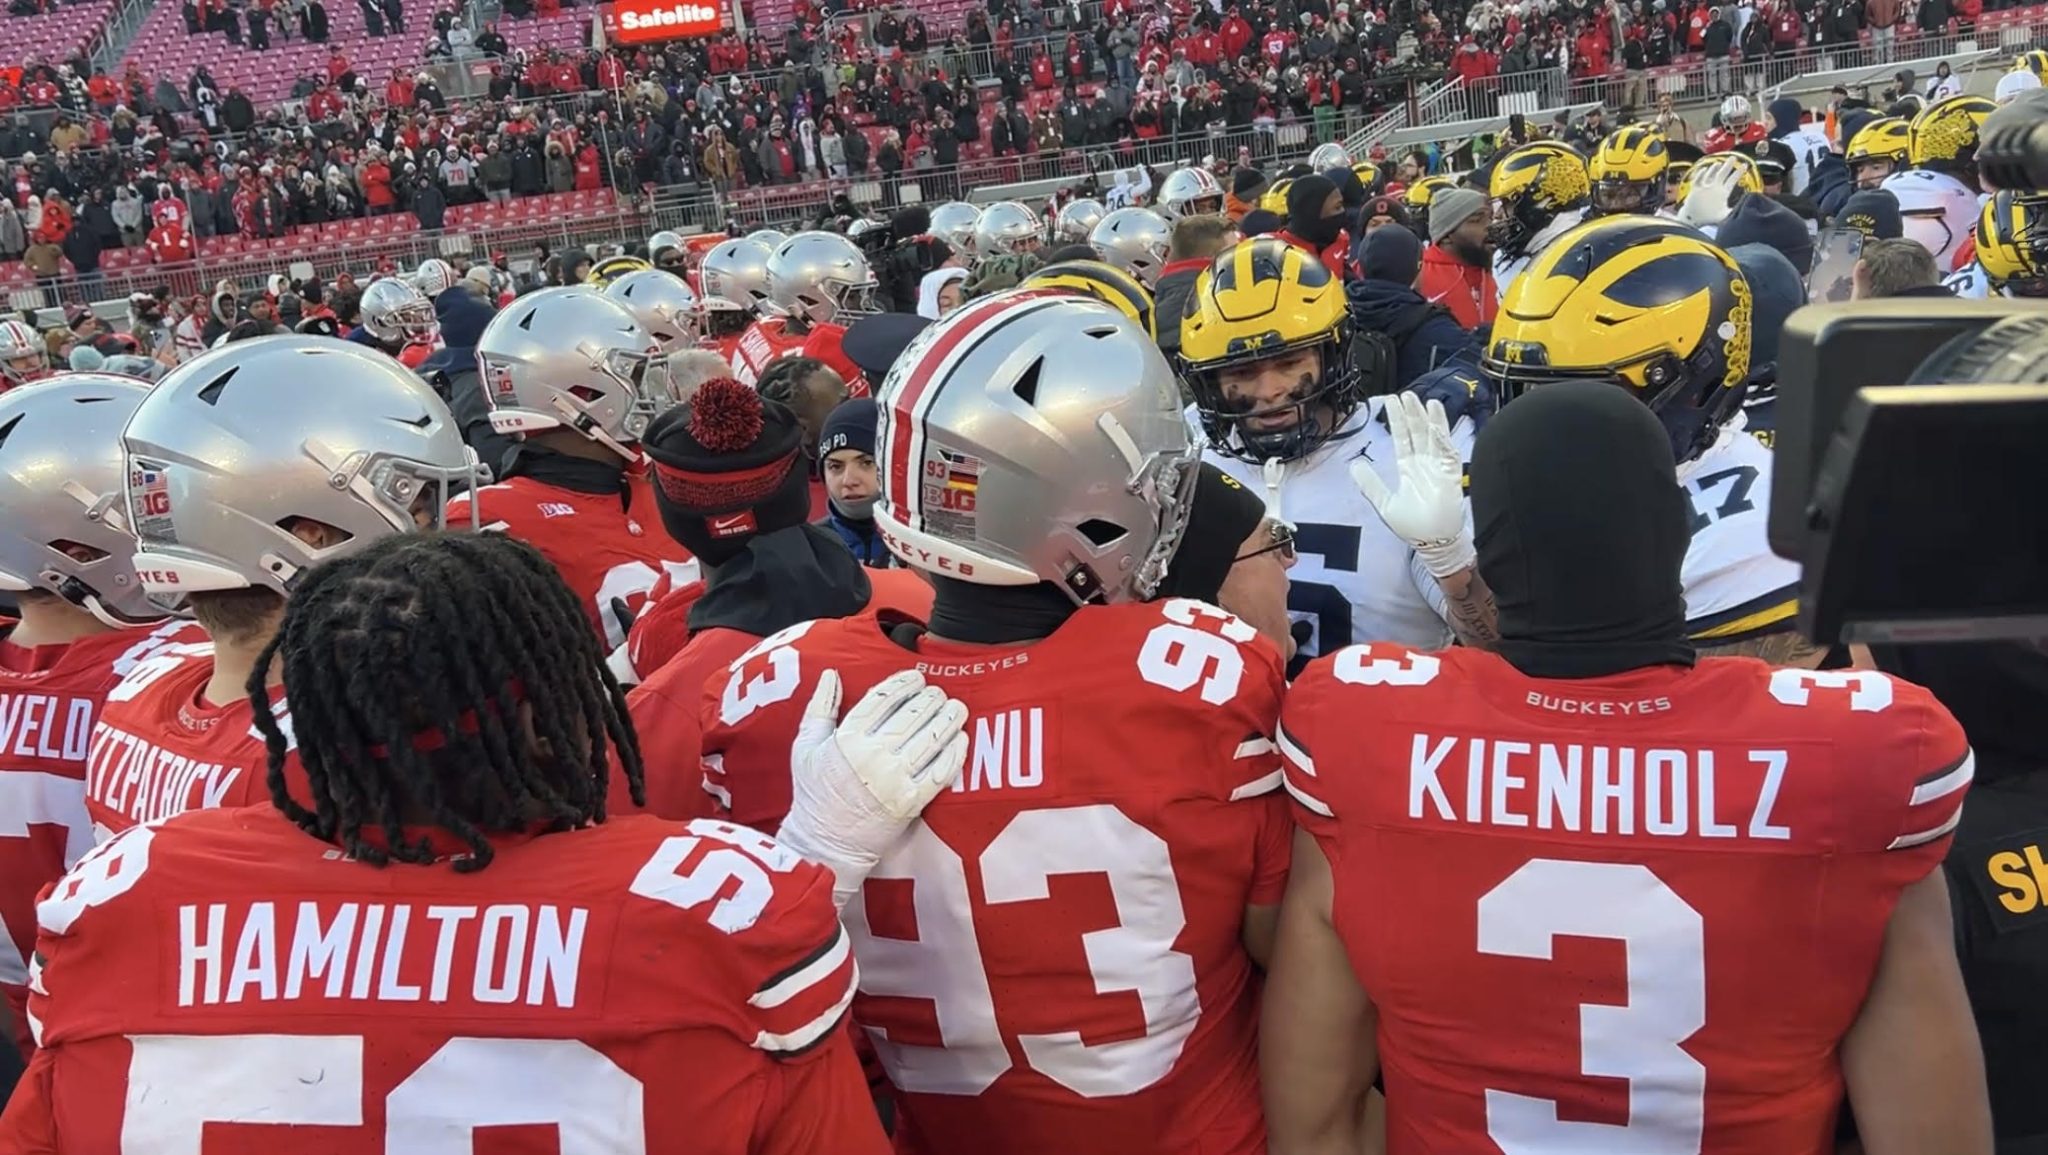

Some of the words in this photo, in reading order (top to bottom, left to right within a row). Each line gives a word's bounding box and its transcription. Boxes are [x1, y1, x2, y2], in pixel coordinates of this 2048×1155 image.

[621, 4, 715, 30] Safelite
[833, 432, 848, 449] PD
[926, 460, 947, 479] 93
[915, 652, 1029, 677] BUCKEYES
[1136, 597, 1258, 707] 93
[1526, 690, 1672, 717] BUCKEYES
[1768, 668, 1893, 713] 3
[1408, 733, 1791, 840] KIENHOLZ
[629, 818, 804, 936] 58
[178, 901, 590, 1008] HAMILTON
[848, 804, 1203, 1098] 93
[1477, 858, 1706, 1155] 3
